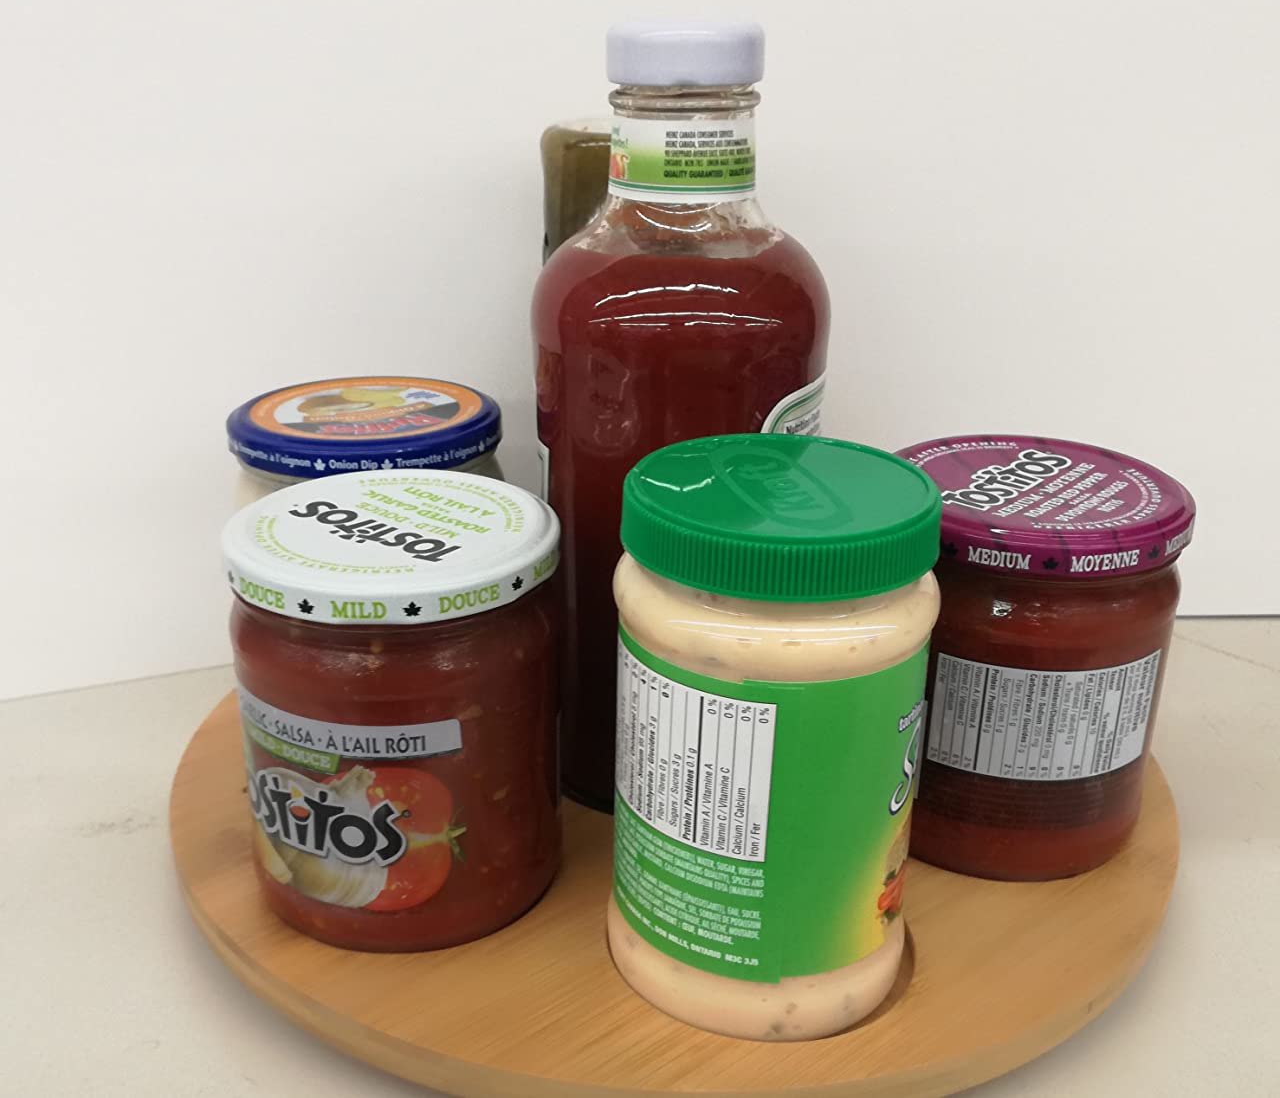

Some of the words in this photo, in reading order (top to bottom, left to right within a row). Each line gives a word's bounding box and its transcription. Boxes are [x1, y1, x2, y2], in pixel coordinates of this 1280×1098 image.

[329, 459, 358, 469] Onion
[361, 460, 378, 470] Dip
[396, 454, 441, 467] Trempette
[362, 490, 418, 511] GARLIC
[992, 493, 1040, 517] MEDIUM
[1045, 463, 1096, 493] MOYENNE
[356, 503, 411, 522] DOUCE
[417, 510, 491, 533] ROASTED
[289, 501, 462, 562] TOSTITOS
[416, 523, 459, 538] MILD
[968, 546, 1031, 570] MEDIUM
[1070, 550, 1140, 572] MOYENNE
[240, 577, 285, 610] DOUCE
[331, 601, 387, 619] MILD
[438, 584, 500, 614] DOUCE
[276, 720, 314, 746] SALSA
[326, 730, 337, 751] À
[342, 736, 380, 754] L'AIL
[386, 733, 426, 753] RÔTI
[282, 745, 330, 769] DOUCE
[704, 764, 712, 773] A
[670, 768, 679, 794] Sucres
[684, 770, 694, 806] Protéines
[702, 775, 712, 803] Vitamine
[719, 775, 729, 808] Vitamine
[670, 800, 679, 827] Sugars
[735, 788, 746, 818] Calcium
[682, 813, 693, 840] Protein
[700, 818, 710, 846] Vitamin
[716, 823, 727, 850] Vitamin
[734, 825, 744, 854] Calcium
[752, 823, 760, 834] Fer
[750, 842, 759, 857] Iron
[691, 944, 721, 958] ONTARIO
